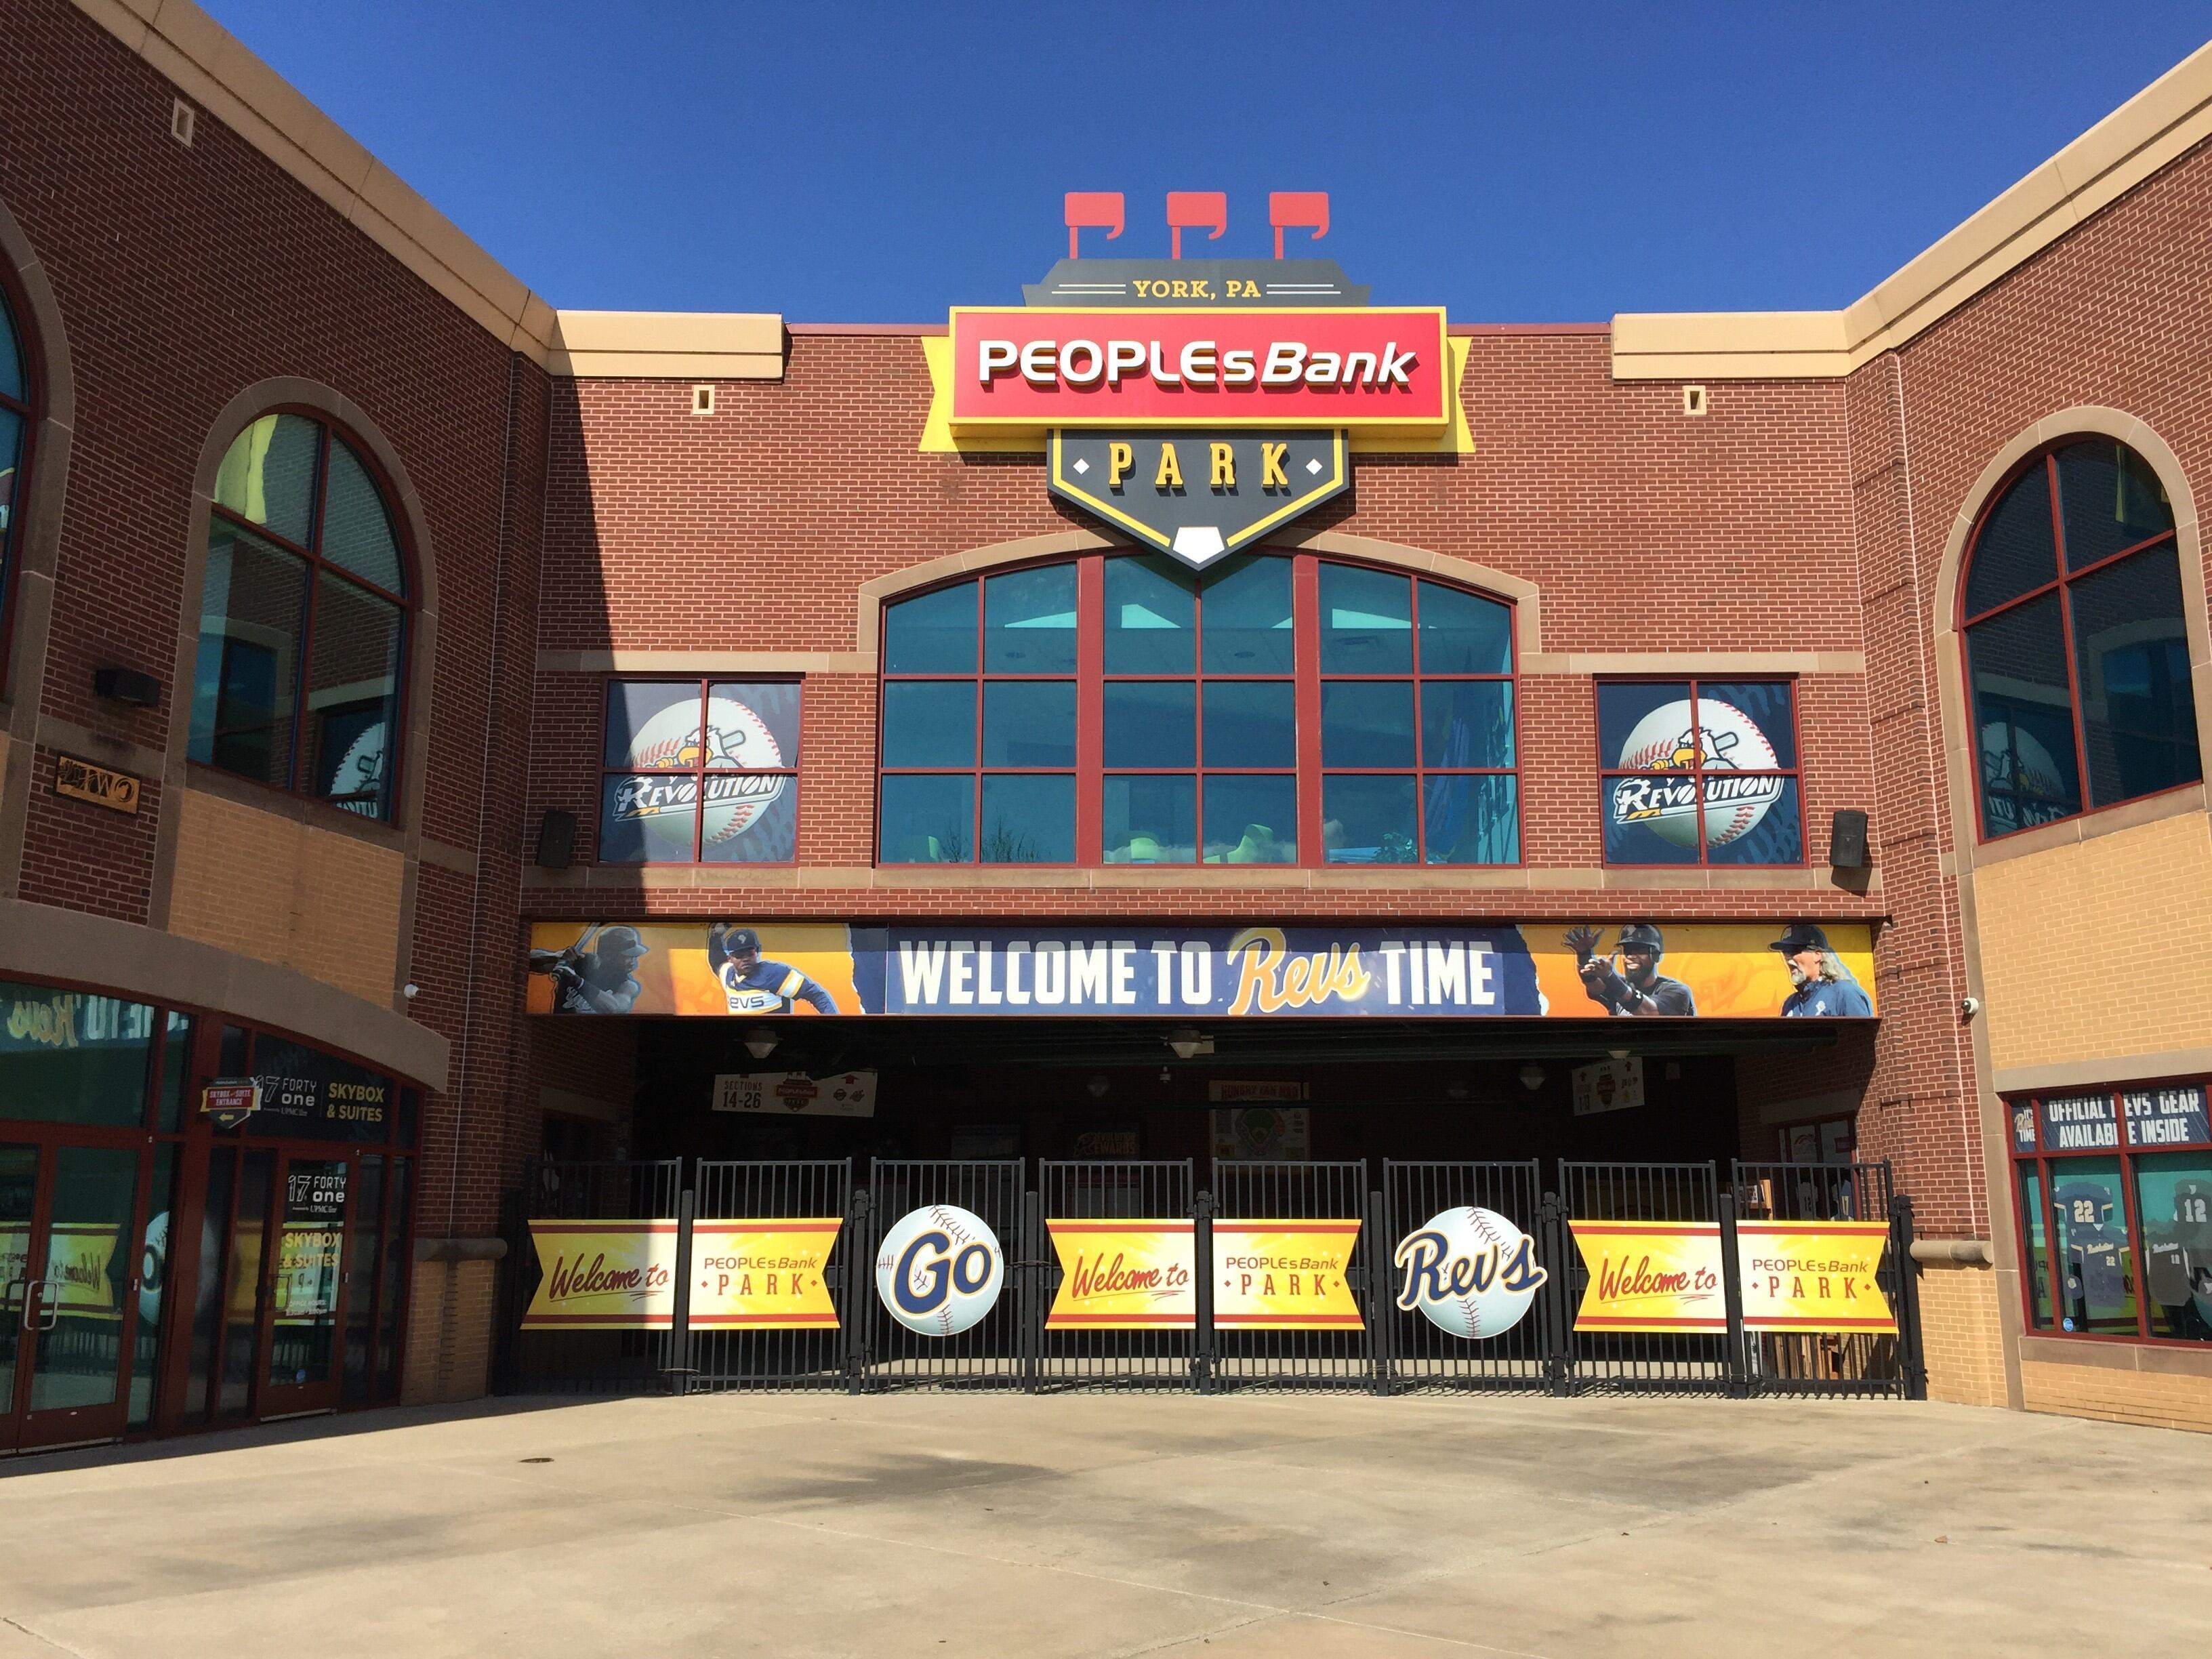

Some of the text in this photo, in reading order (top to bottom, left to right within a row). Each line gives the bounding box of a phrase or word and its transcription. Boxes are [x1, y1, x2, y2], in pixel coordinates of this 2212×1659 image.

[1132, 280, 1262, 300] YORK, PA
[978, 339, 1418, 387] PEOPLEsBank
[1108, 441, 1291, 489] PARK
[616, 775, 775, 812] REVOUTION
[1614, 775, 1774, 815] REVOUTION
[900, 928, 1496, 1016] WELCOME TO Revs TIME
[281, 1078, 317, 1092] FORTY
[328, 1082, 385, 1103] SKYBOX
[724, 1080, 763, 1092] SECTIONS
[216, 1098, 243, 1106] ENTRANCE
[281, 1093, 316, 1106] one
[722, 1091, 762, 1109] 14-26
[2048, 1097, 2106, 1122] OFFICIAL
[2158, 1088, 2200, 1115] GEAR
[327, 1103, 336, 1119] &
[339, 1105, 384, 1123] SUITES
[2140, 1118, 2190, 1144] INSIDE
[288, 1174, 346, 1202] 17 FORTY
[312, 1191, 345, 1203] one
[2074, 1200, 2095, 1223] 22
[2184, 1199, 2207, 1223] 12
[285, 1232, 340, 1248] SKYBOX
[283, 1253, 340, 1269] & SUITES
[893, 1229, 994, 1316] Go
[1395, 1229, 1548, 1311] Revs
[2106, 1255, 2116, 1267] 22
[550, 1252, 670, 1300] Welcome to
[718, 1273, 804, 1296] PARK
[1072, 1252, 1189, 1298] Welcome to
[1240, 1273, 1328, 1296] PARK
[1599, 1254, 1718, 1301] Welcome to
[1768, 1275, 1858, 1299] PARK
